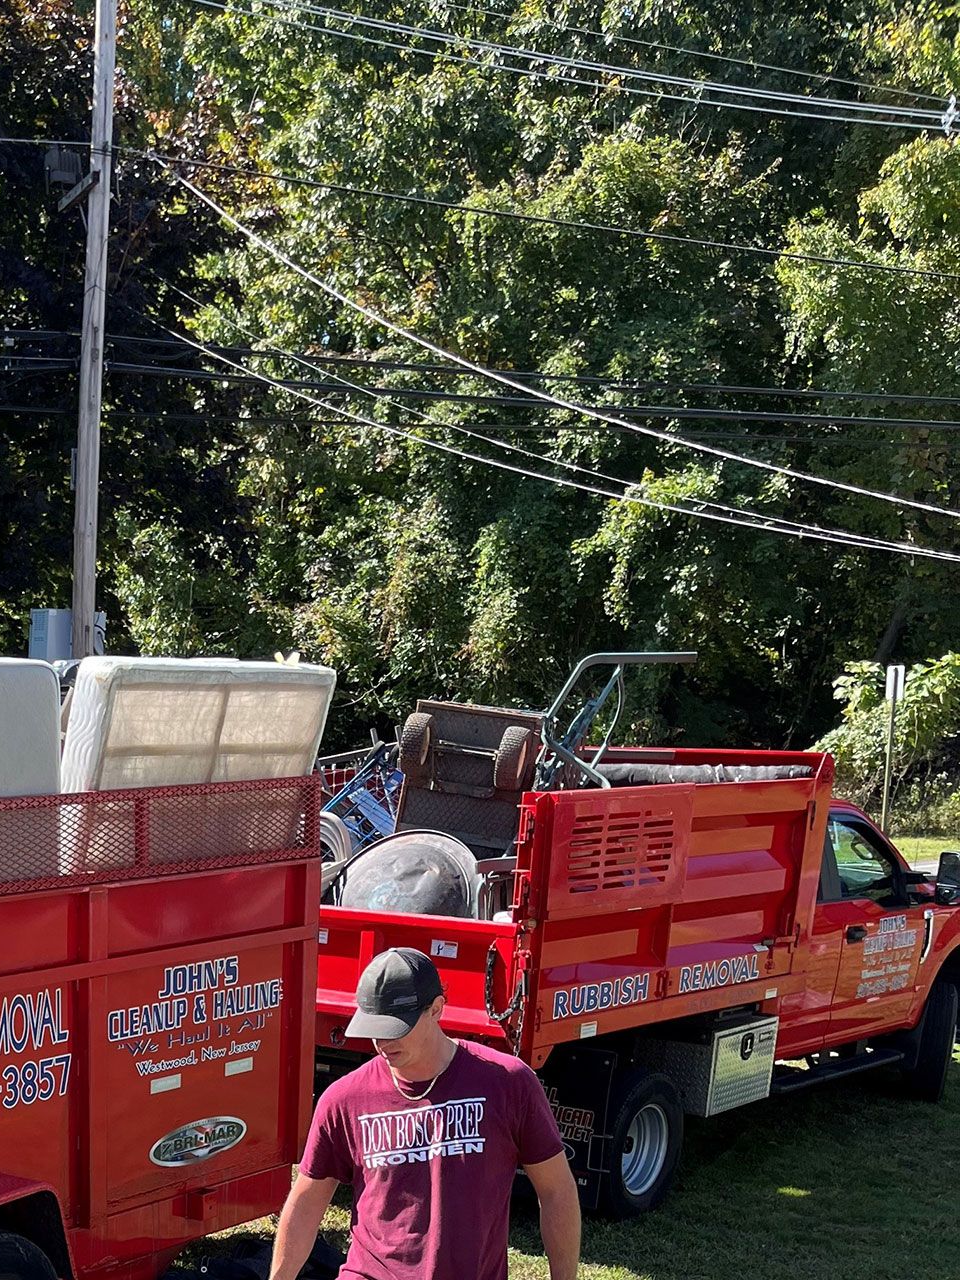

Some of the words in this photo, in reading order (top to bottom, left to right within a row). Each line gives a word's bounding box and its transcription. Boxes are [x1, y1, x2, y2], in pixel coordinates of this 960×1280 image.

[158, 955, 239, 999] JOHN'S
[553, 973, 649, 1020] RUBBISH
[679, 954, 759, 993] REMOVAL
[107, 997, 188, 1042] CLEANUP
[193, 994, 207, 1025] &
[212, 978, 280, 1021] HAULING
[135, 1050, 199, 1077] Westwood,
[201, 1045, 227, 1061] New
[228, 1038, 262, 1055] Jersey
[167, 1025, 211, 1050] Haul
[360, 1116, 392, 1154] DON
[395, 1108, 444, 1149] BOSCO
[445, 1102, 484, 1141] PREP
[365, 1142, 484, 1169] IRONMEN
